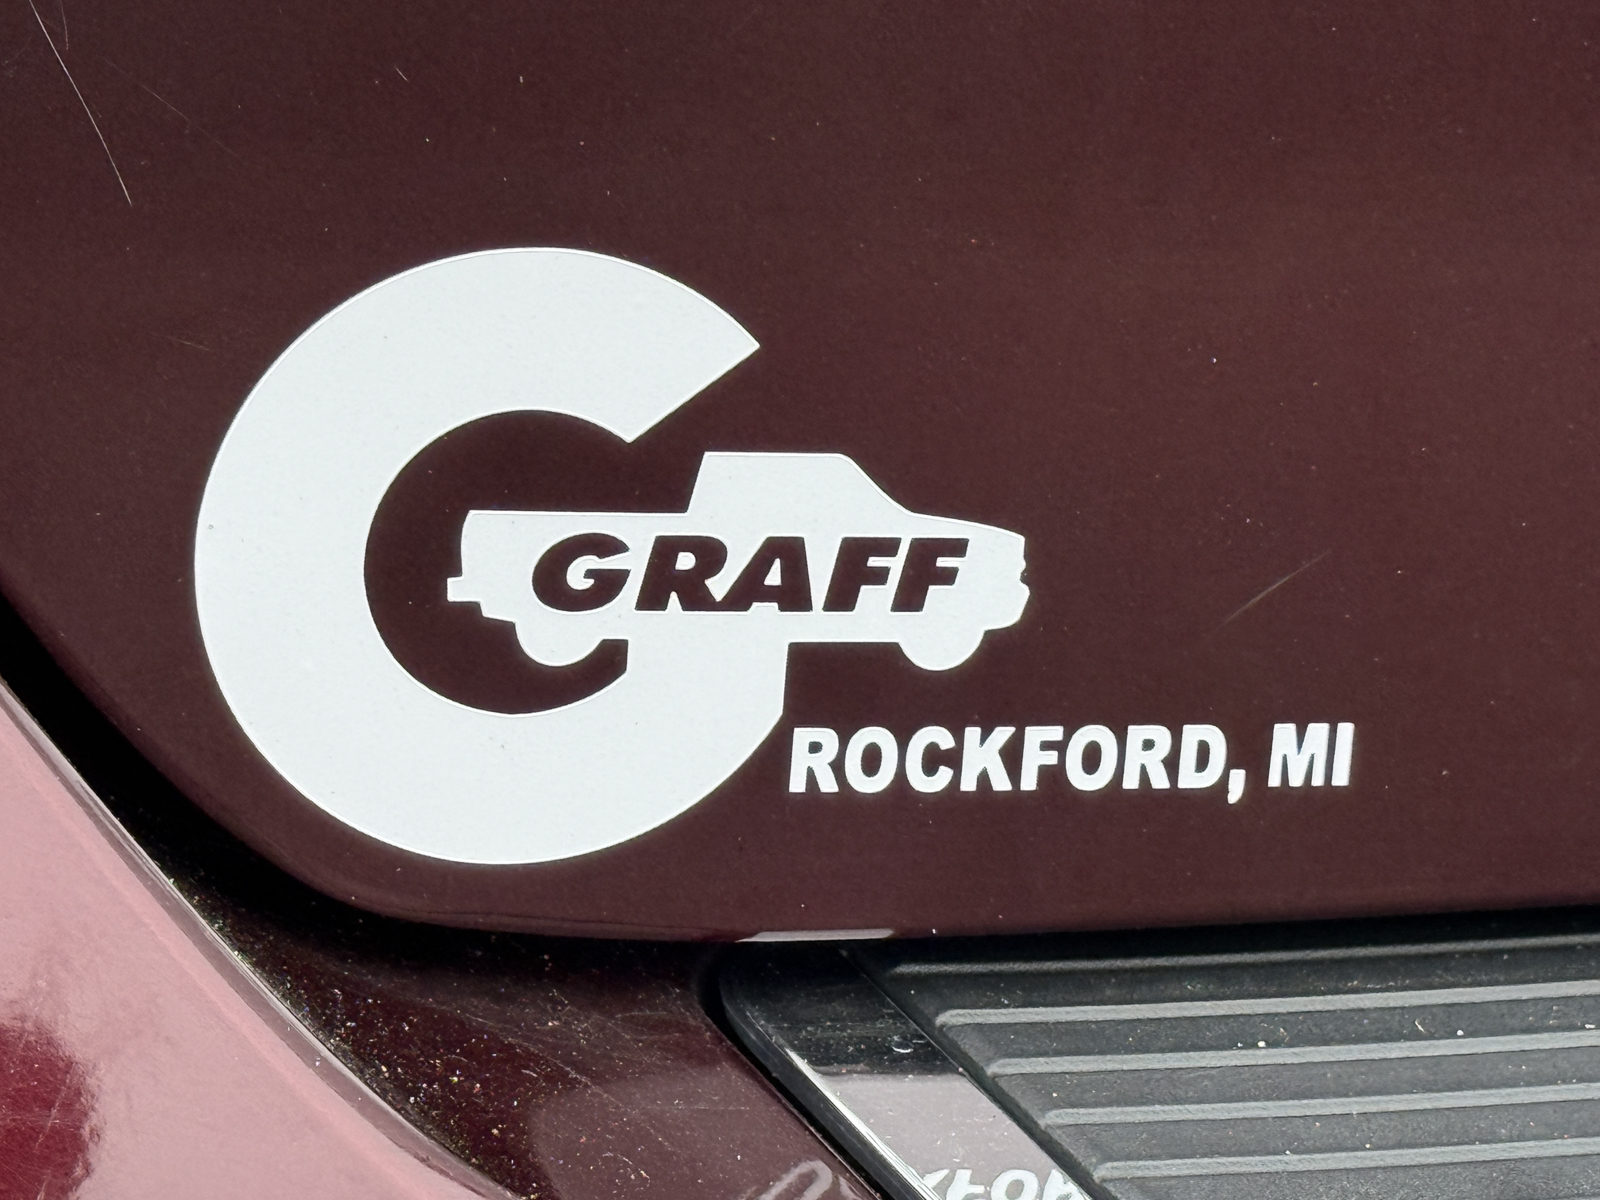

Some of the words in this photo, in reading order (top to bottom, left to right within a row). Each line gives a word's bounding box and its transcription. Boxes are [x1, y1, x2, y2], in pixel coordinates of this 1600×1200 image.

[531, 532, 970, 613] GRAFF
[788, 724, 1247, 805] ROCKFORD,
[1267, 722, 1356, 788] MI
